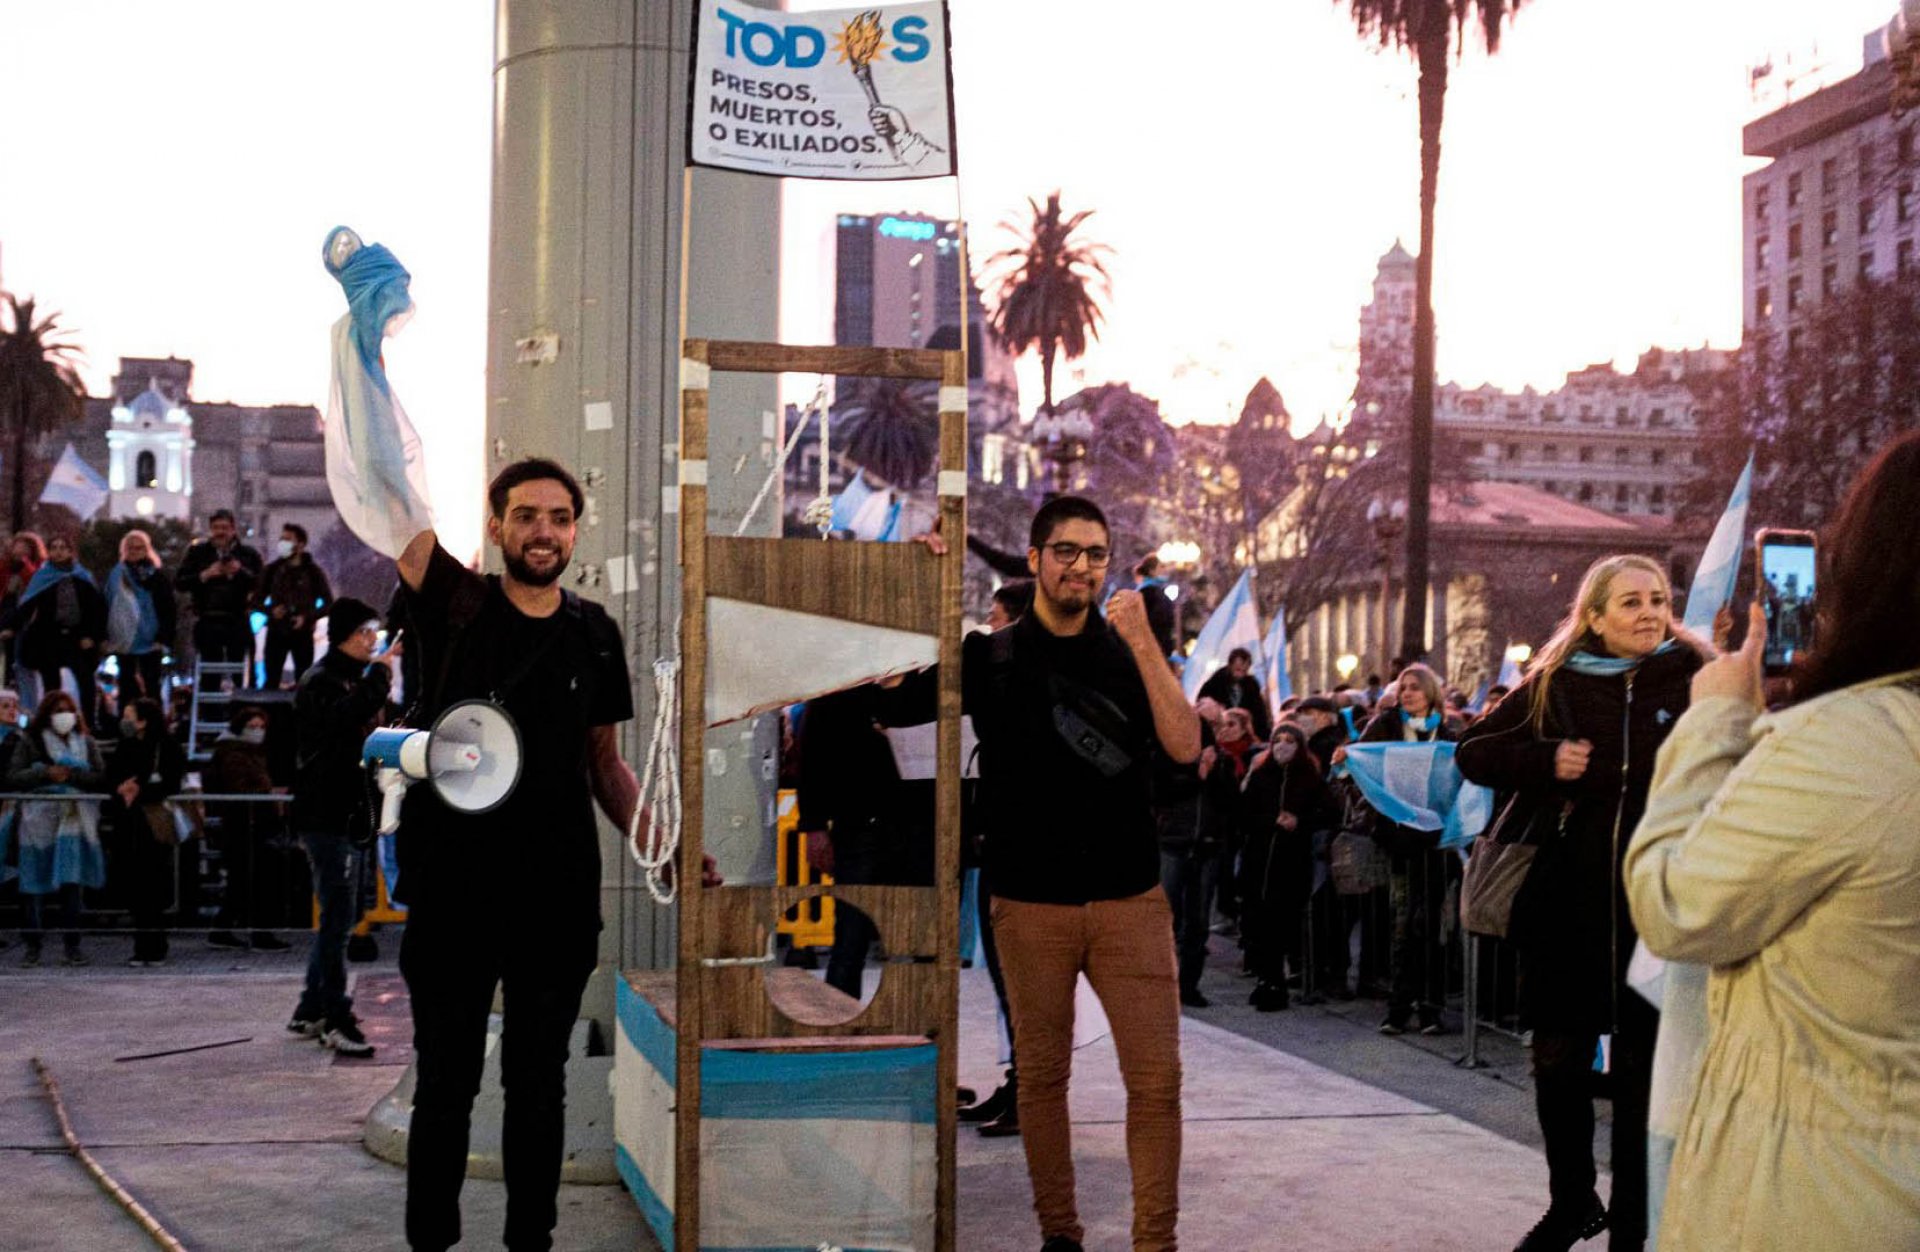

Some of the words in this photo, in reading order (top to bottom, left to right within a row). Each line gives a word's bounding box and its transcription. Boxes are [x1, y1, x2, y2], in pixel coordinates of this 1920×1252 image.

[711, 68, 817, 104] PRESOS,
[709, 95, 843, 130] MUERTOS,
[708, 123, 727, 141] O
[735, 127, 882, 154] EXILIADOS.
